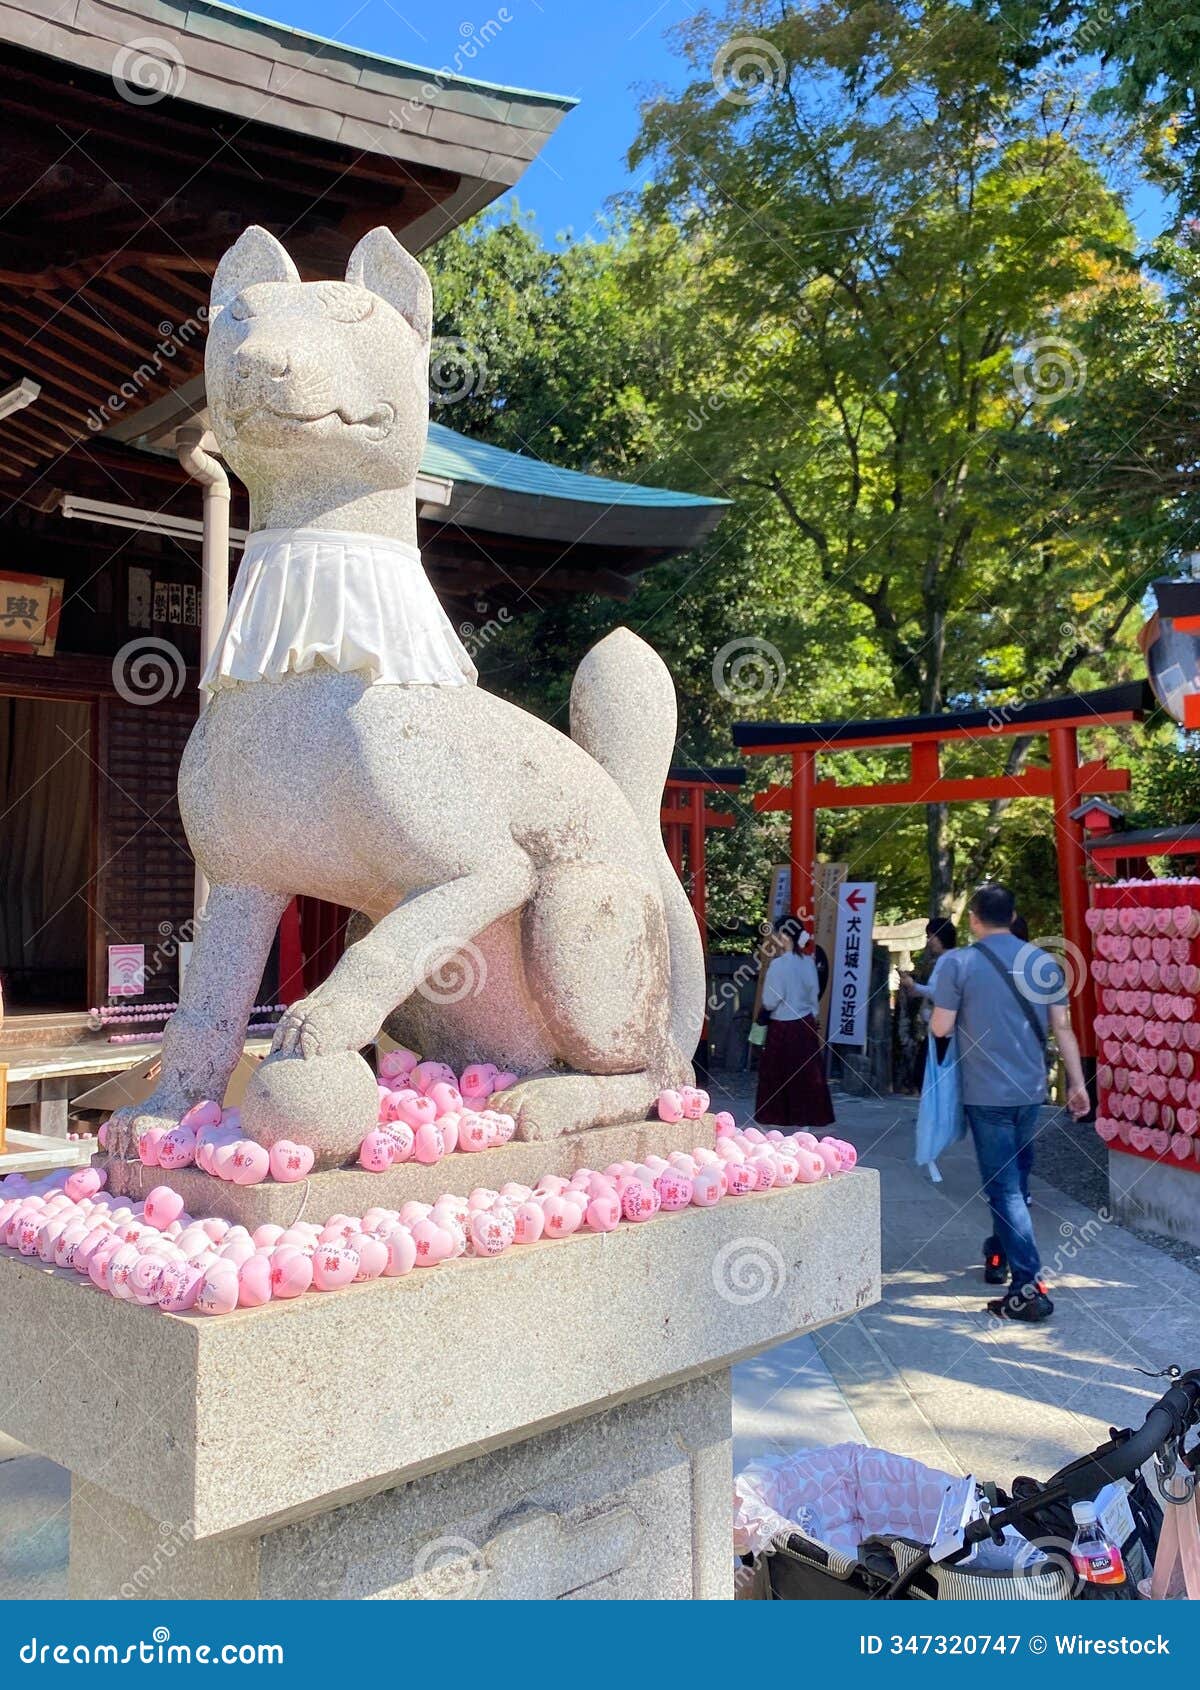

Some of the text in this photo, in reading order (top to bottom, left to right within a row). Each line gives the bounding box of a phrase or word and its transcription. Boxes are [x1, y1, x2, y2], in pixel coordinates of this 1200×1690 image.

[839, 917, 862, 1036] 犬山城への近道
[324, 1257, 339, 1271] 縁
